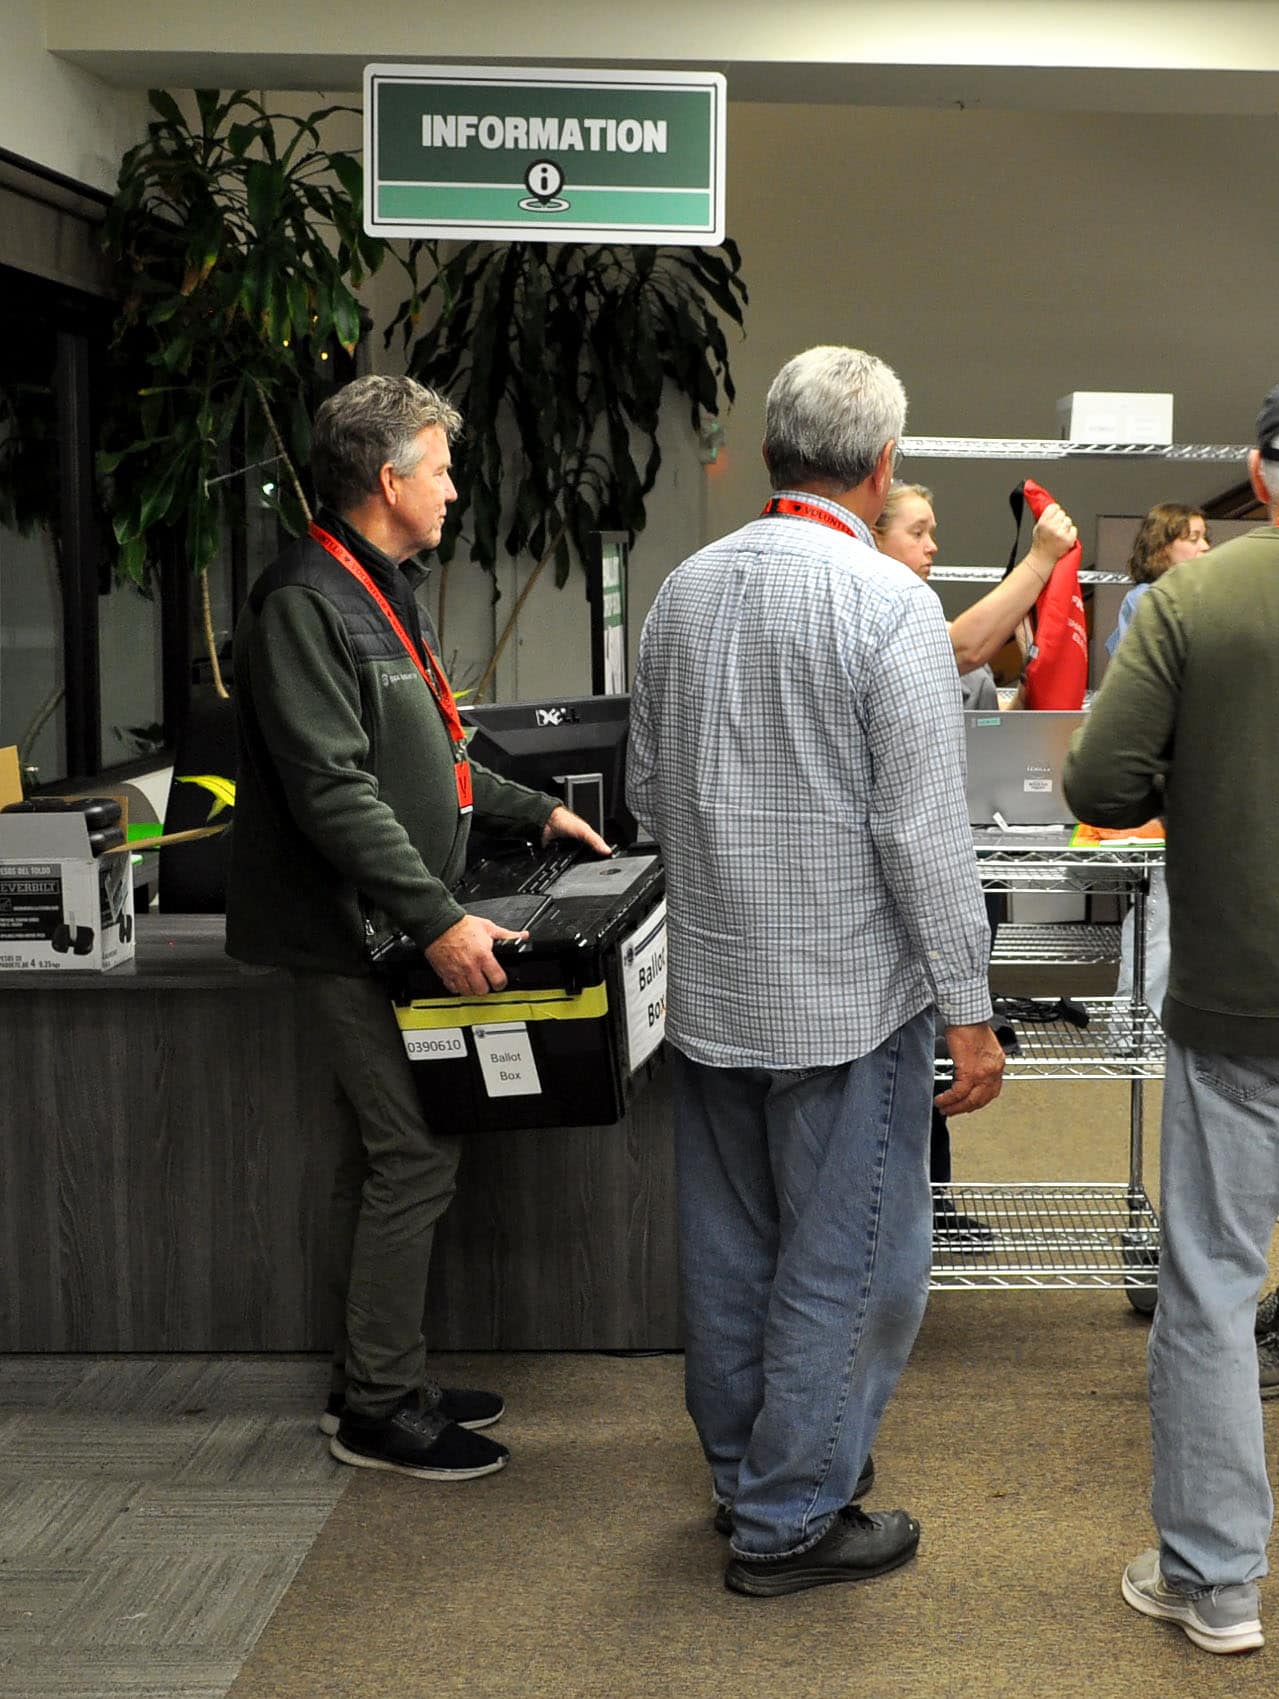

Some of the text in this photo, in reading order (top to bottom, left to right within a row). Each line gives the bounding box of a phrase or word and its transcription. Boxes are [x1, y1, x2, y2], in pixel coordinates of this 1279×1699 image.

[421, 114, 667, 153] INFORMATION
[0, 882, 56, 892] EVERBILT
[407, 1039, 461, 1053] 0390610
[490, 1052, 522, 1063] Ballot
[500, 1071, 521, 1081] Box
